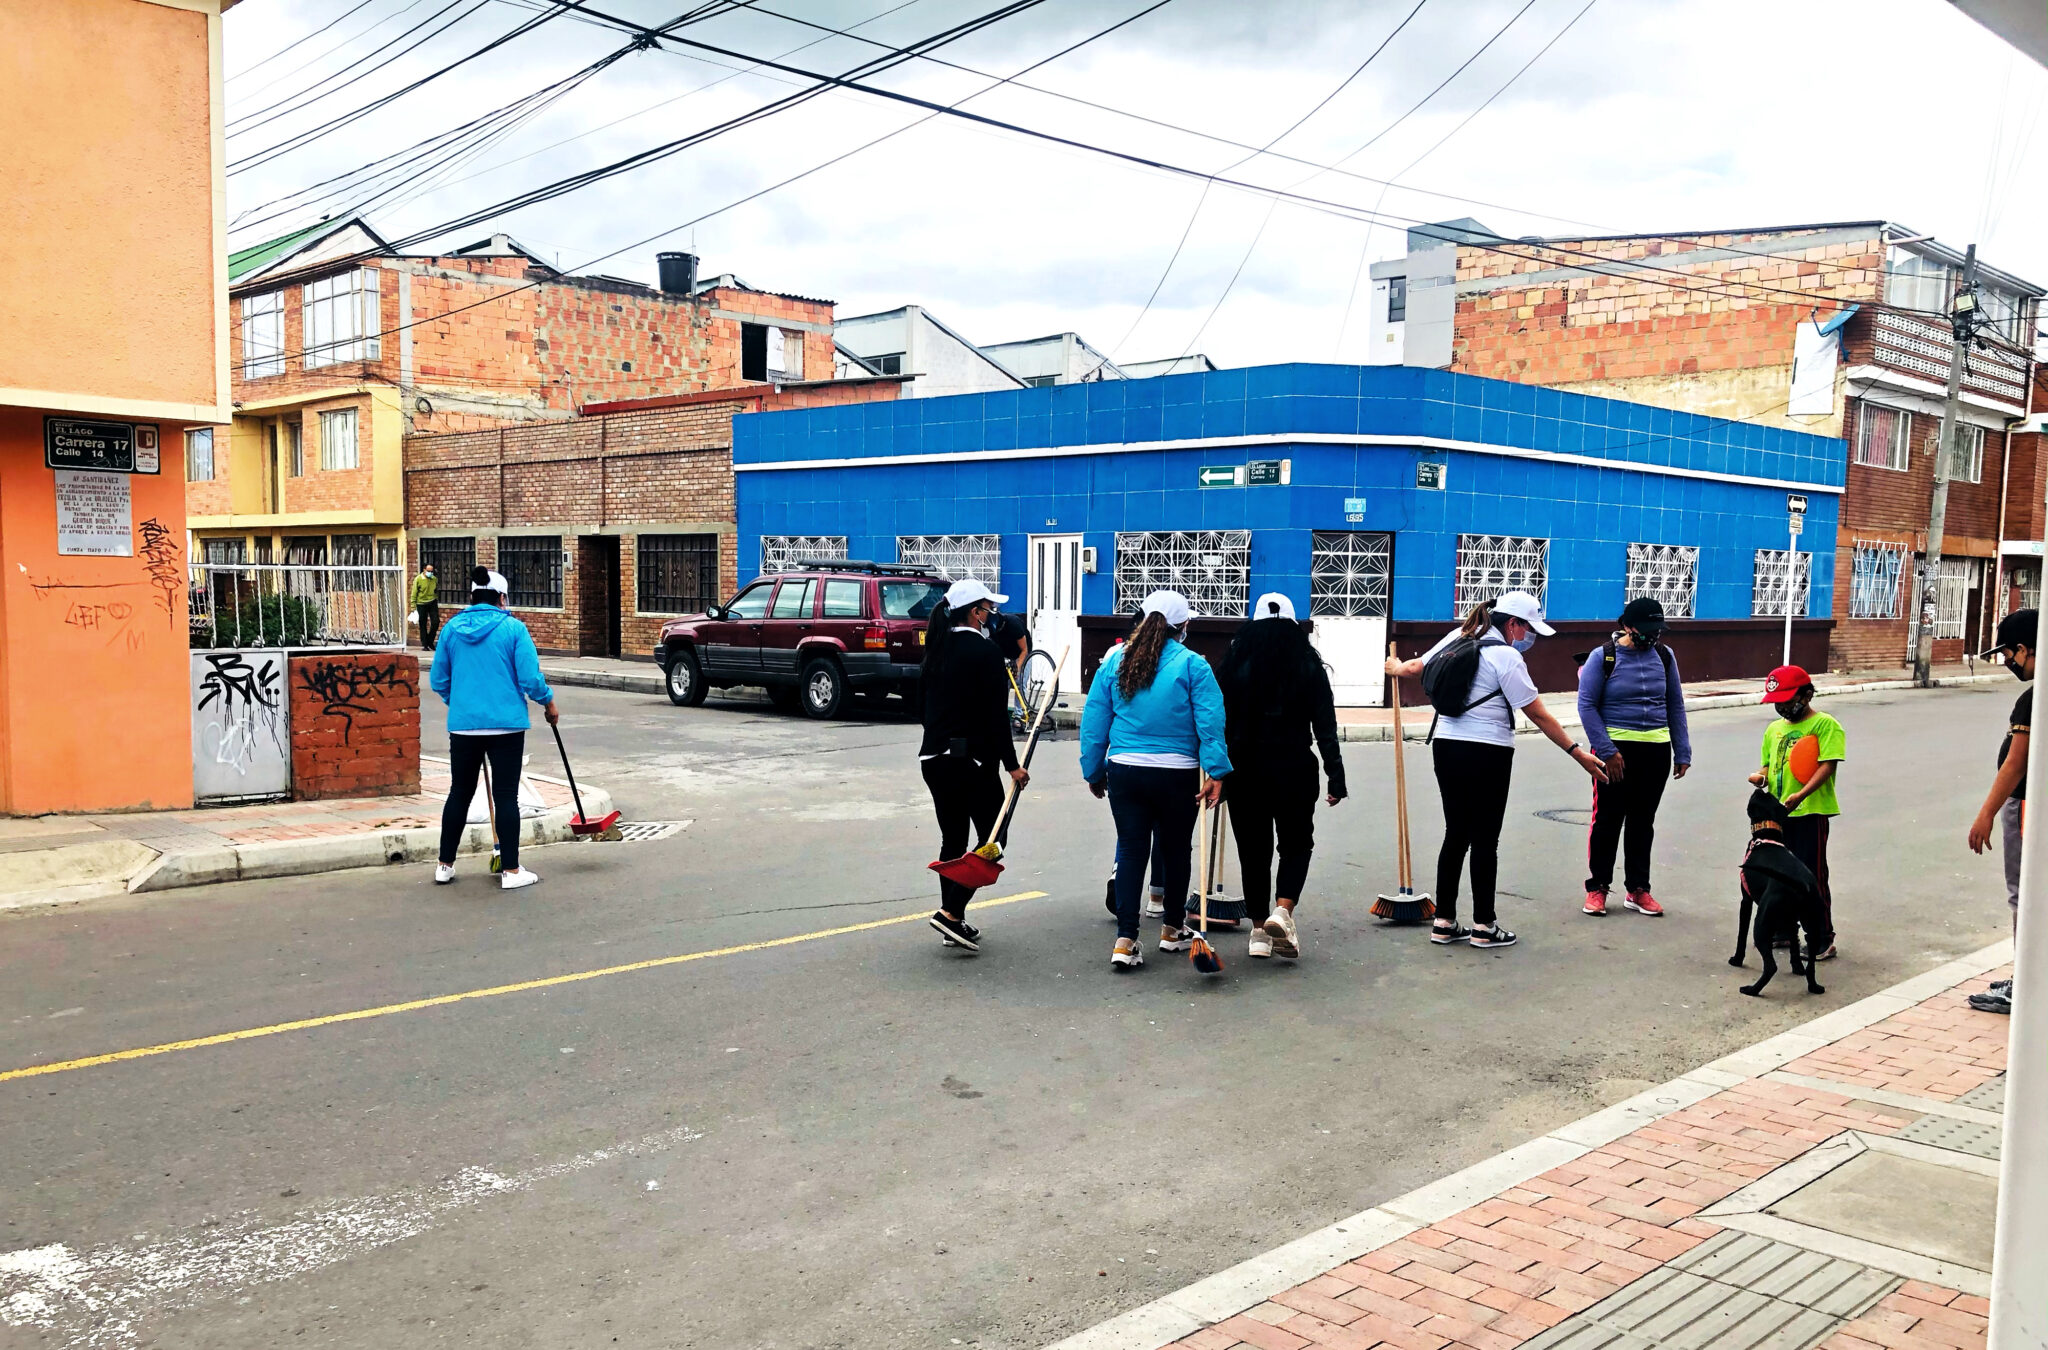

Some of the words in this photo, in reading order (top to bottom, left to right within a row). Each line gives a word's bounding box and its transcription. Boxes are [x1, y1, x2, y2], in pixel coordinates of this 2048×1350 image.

[55, 435, 105, 449] Carrera
[113, 440, 129, 450] 17
[55, 447, 81, 456] Calle
[91, 450, 104, 458] 14
